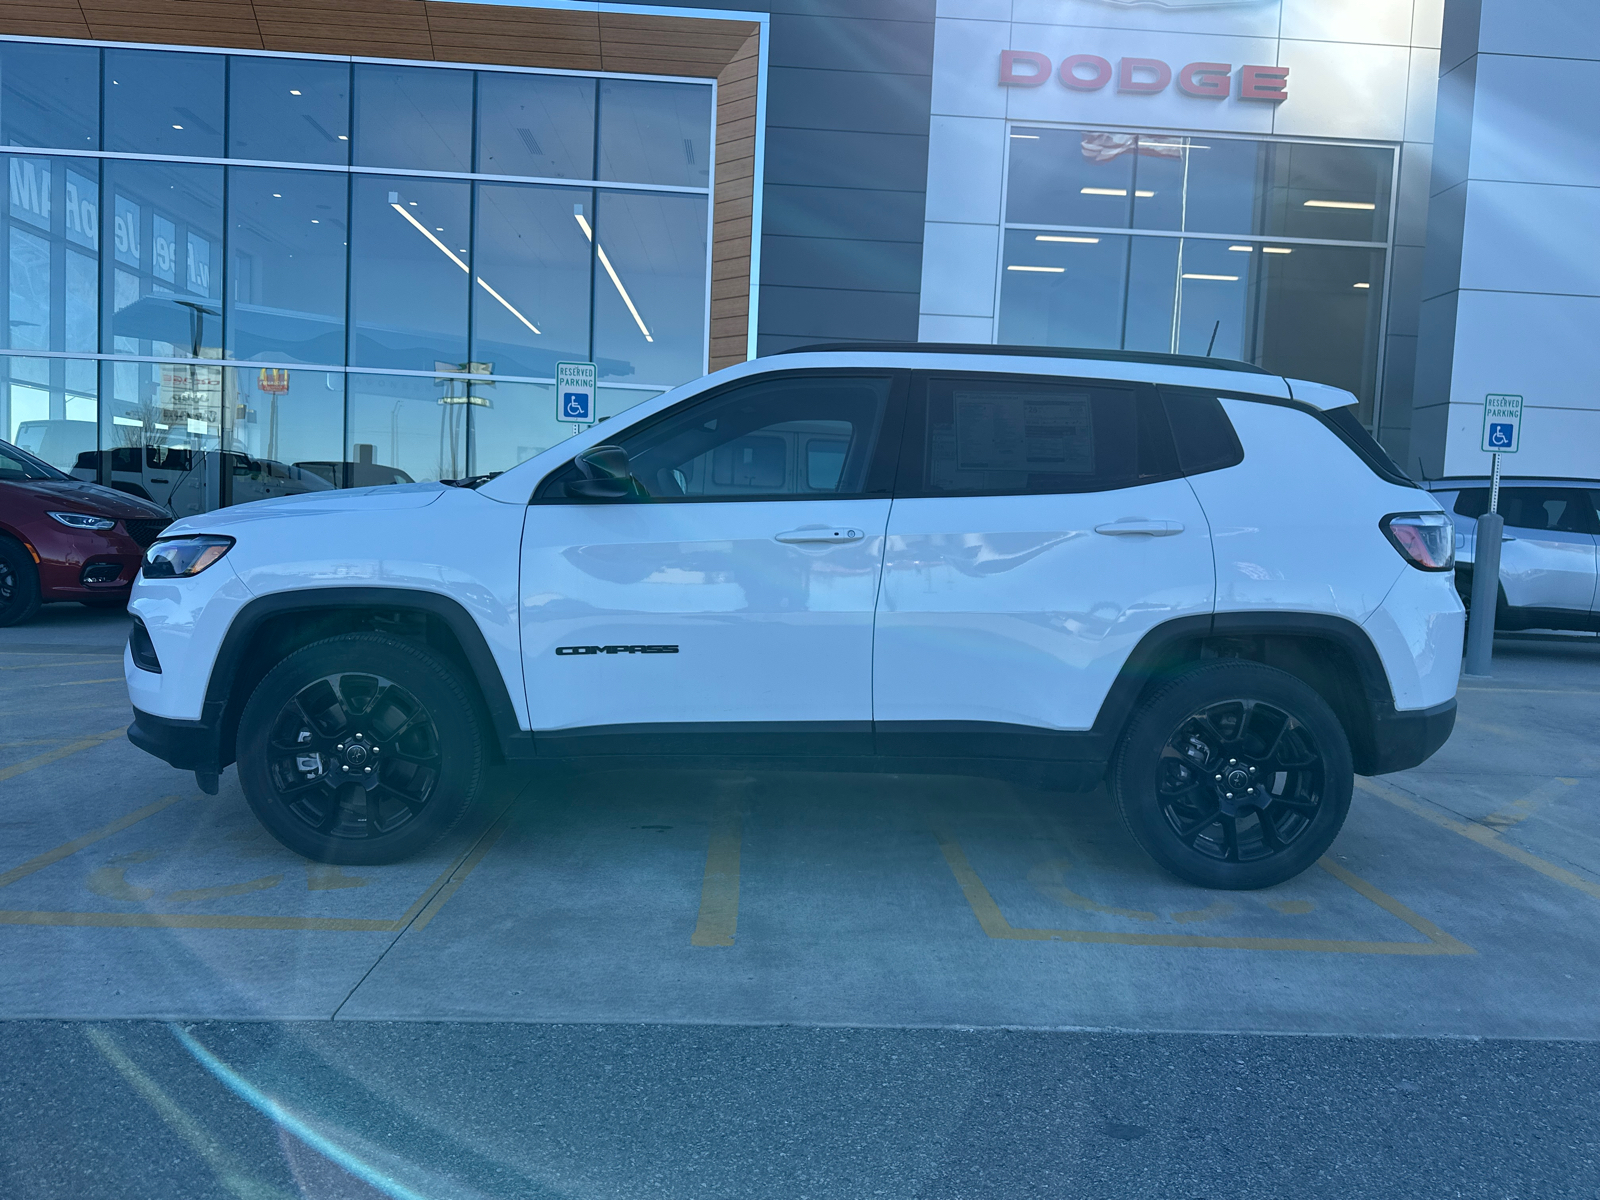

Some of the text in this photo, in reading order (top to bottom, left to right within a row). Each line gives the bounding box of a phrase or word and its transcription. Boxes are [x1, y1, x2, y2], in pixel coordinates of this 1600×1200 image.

[998, 49, 1289, 103] DODGE
[560, 367, 593, 377] RESERVED
[560, 378, 593, 388] PARKING
[1488, 398, 1520, 408] RESERVED
[1487, 409, 1519, 418] PARKING
[555, 645, 679, 656] COMPASS
